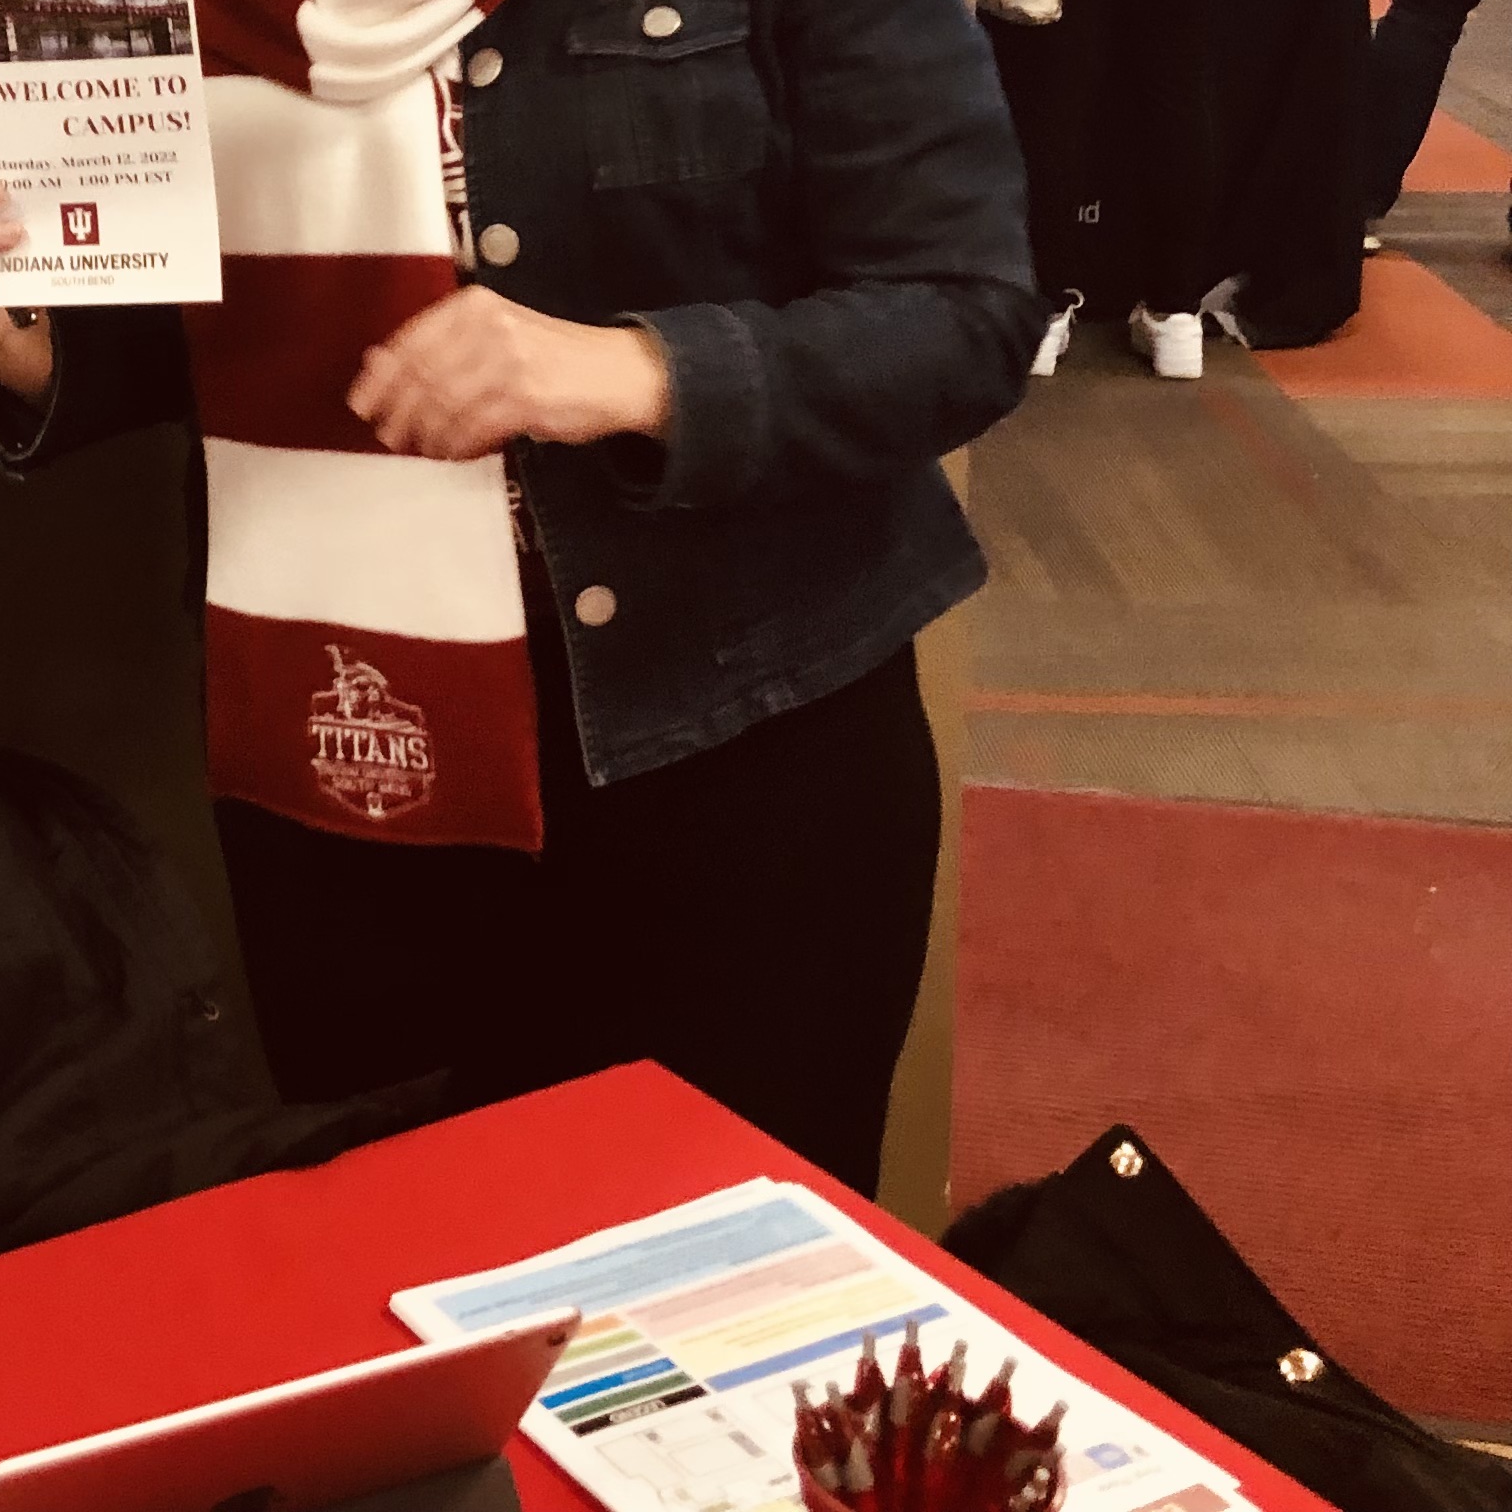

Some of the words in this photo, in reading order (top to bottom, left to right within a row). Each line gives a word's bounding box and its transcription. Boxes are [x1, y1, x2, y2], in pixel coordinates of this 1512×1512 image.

[147, 74, 188, 97] TO
[62, 110, 192, 137] CAMPUS!
[61, 154, 112, 170] March
[140, 149, 179, 165] 2022
[38, 176, 63, 190] AM
[114, 171, 139, 186] PM
[144, 170, 174, 184] EST
[70, 252, 169, 271] UNIVERSITY
[51, 276, 86, 287] SOUTH
[88, 274, 115, 287] BEND
[311, 723, 429, 771] TITANS
